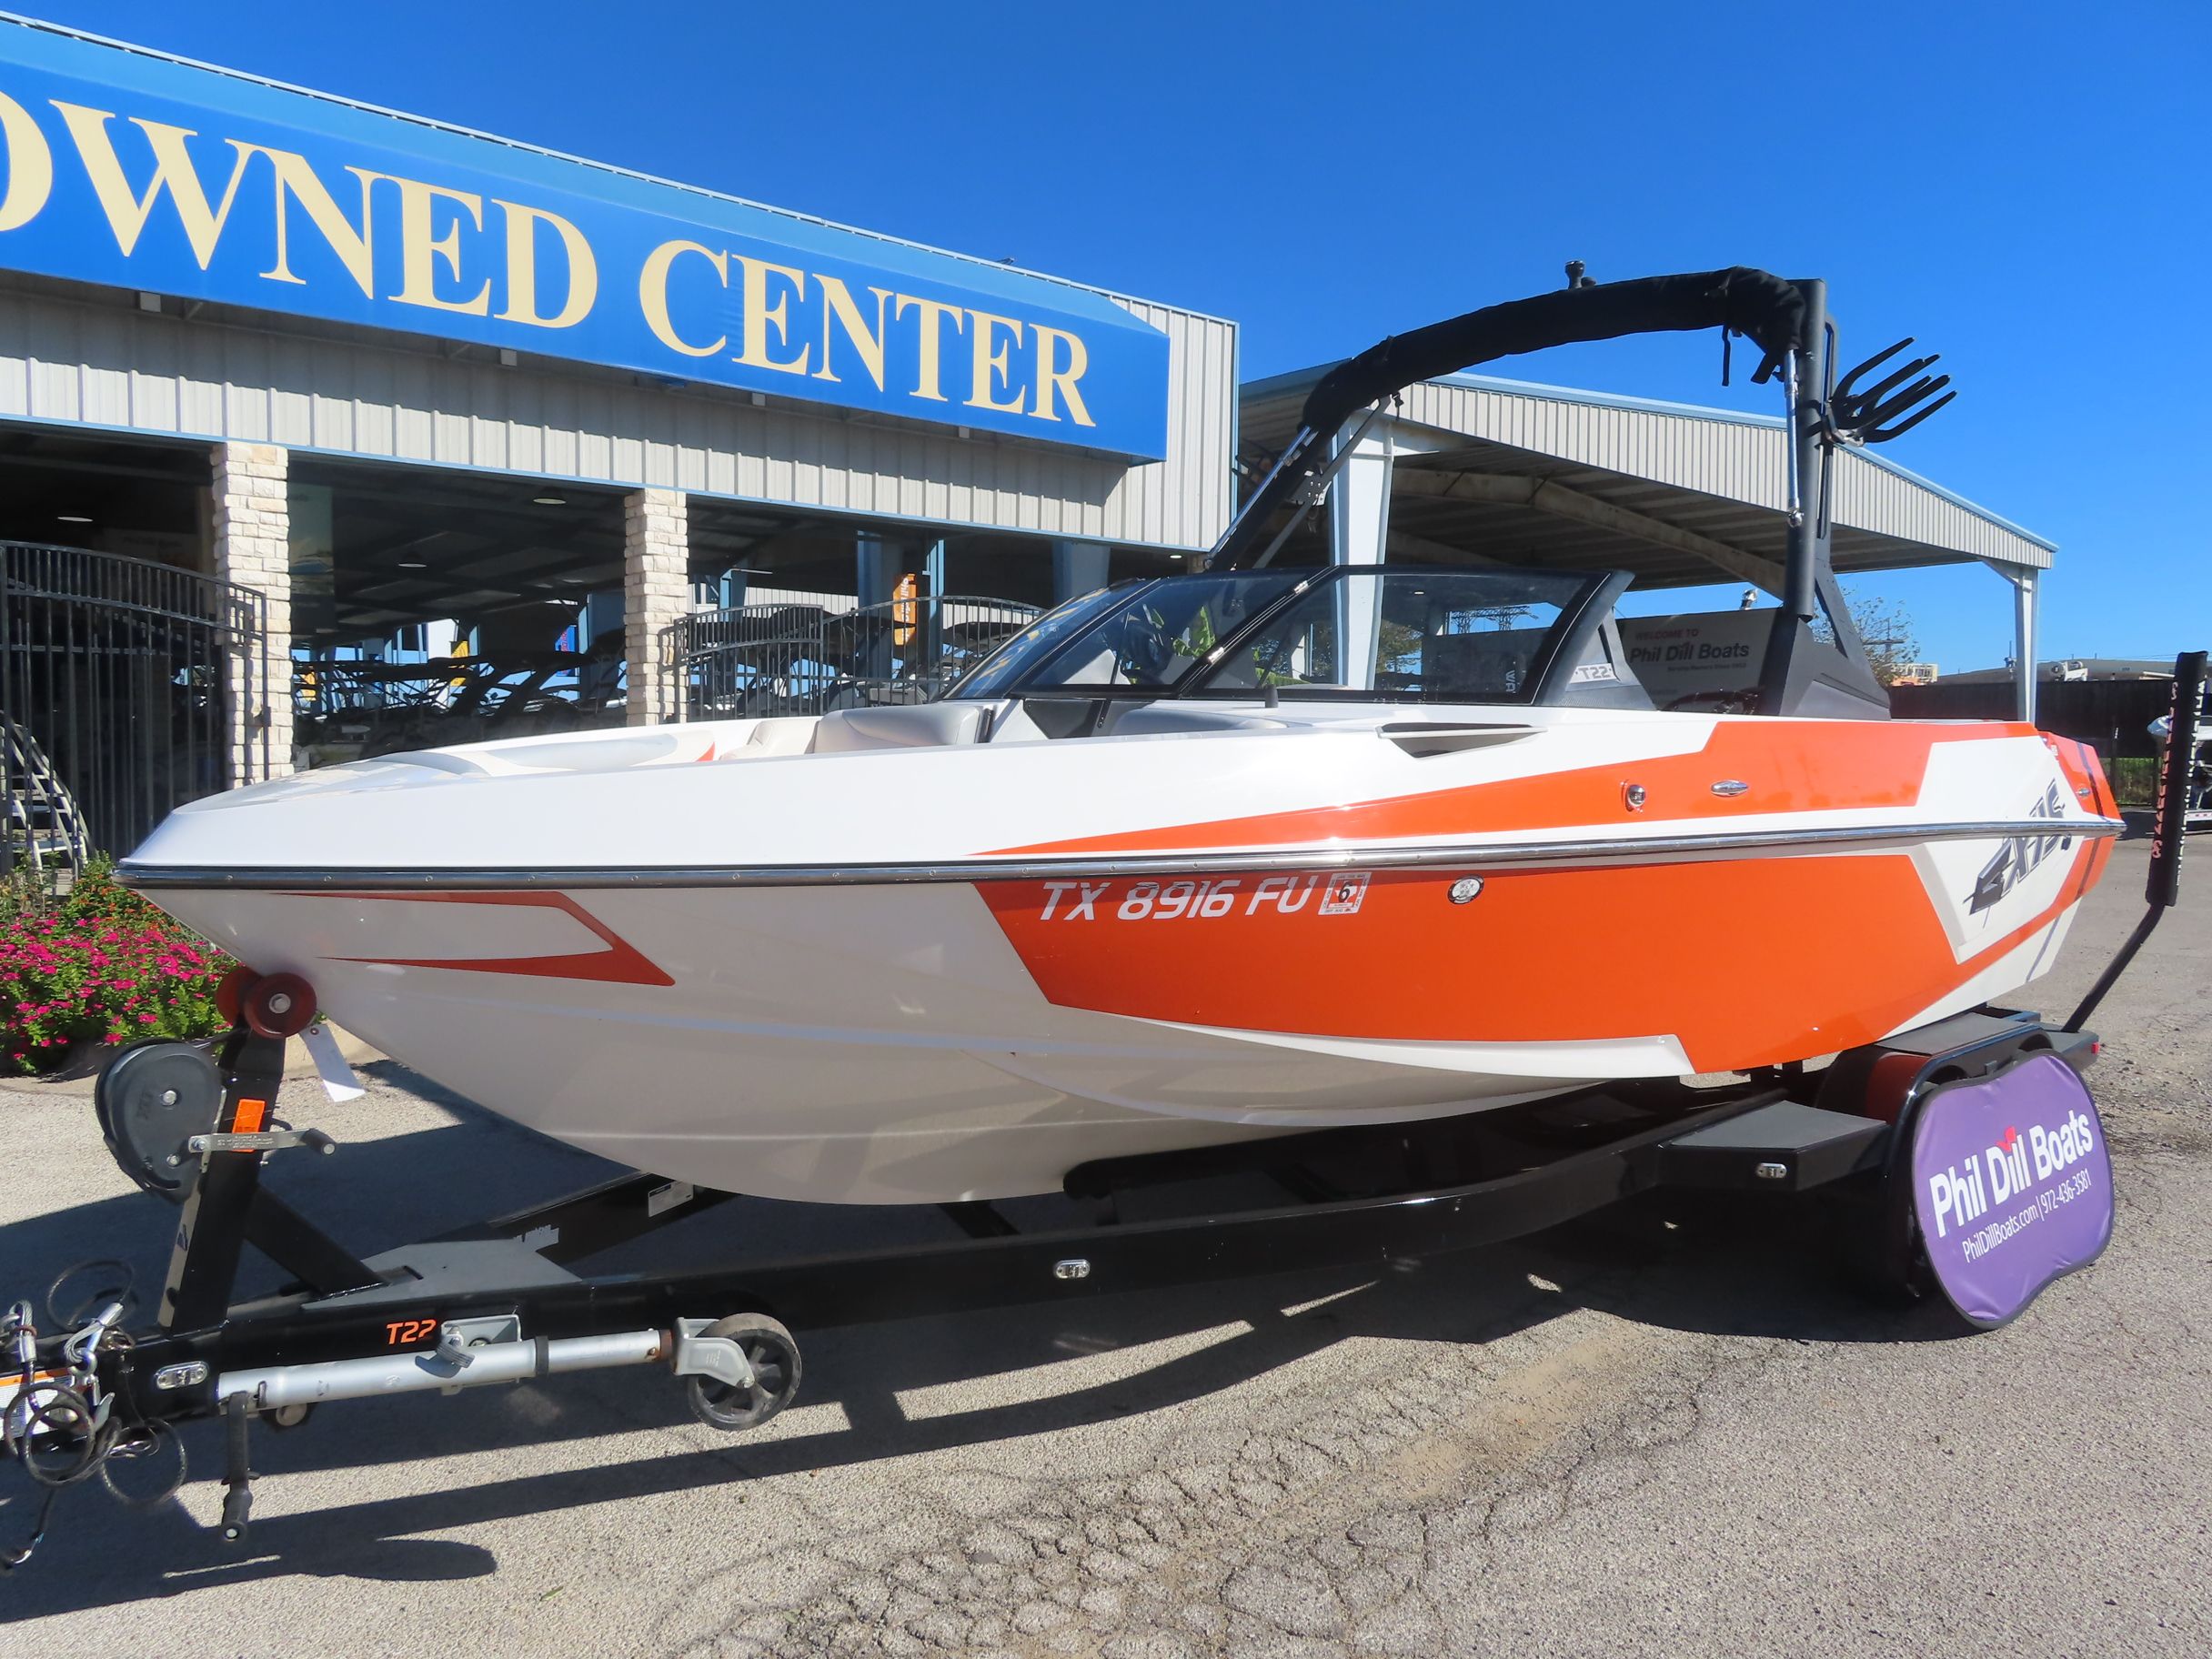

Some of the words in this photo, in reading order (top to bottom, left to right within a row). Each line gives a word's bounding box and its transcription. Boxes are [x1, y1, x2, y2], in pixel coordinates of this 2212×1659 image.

[639, 239, 1096, 427] CENTER
[1578, 666, 1611, 679] T22
[1630, 646, 1662, 663] Phil
[1665, 642, 1694, 661] Dill
[1698, 642, 1750, 659] Boats
[1040, 881, 1111, 920] TX
[1117, 880, 1242, 920] 8916
[1245, 876, 1318, 916] FU
[1929, 1154, 1987, 1238] Phil
[1986, 1130, 2032, 1205] Dill
[2028, 1110, 2094, 1181] Boats
[1962, 1204, 2039, 1262] PhilDillBoats.com
[2040, 1168, 2092, 1214] 972-436-3581
